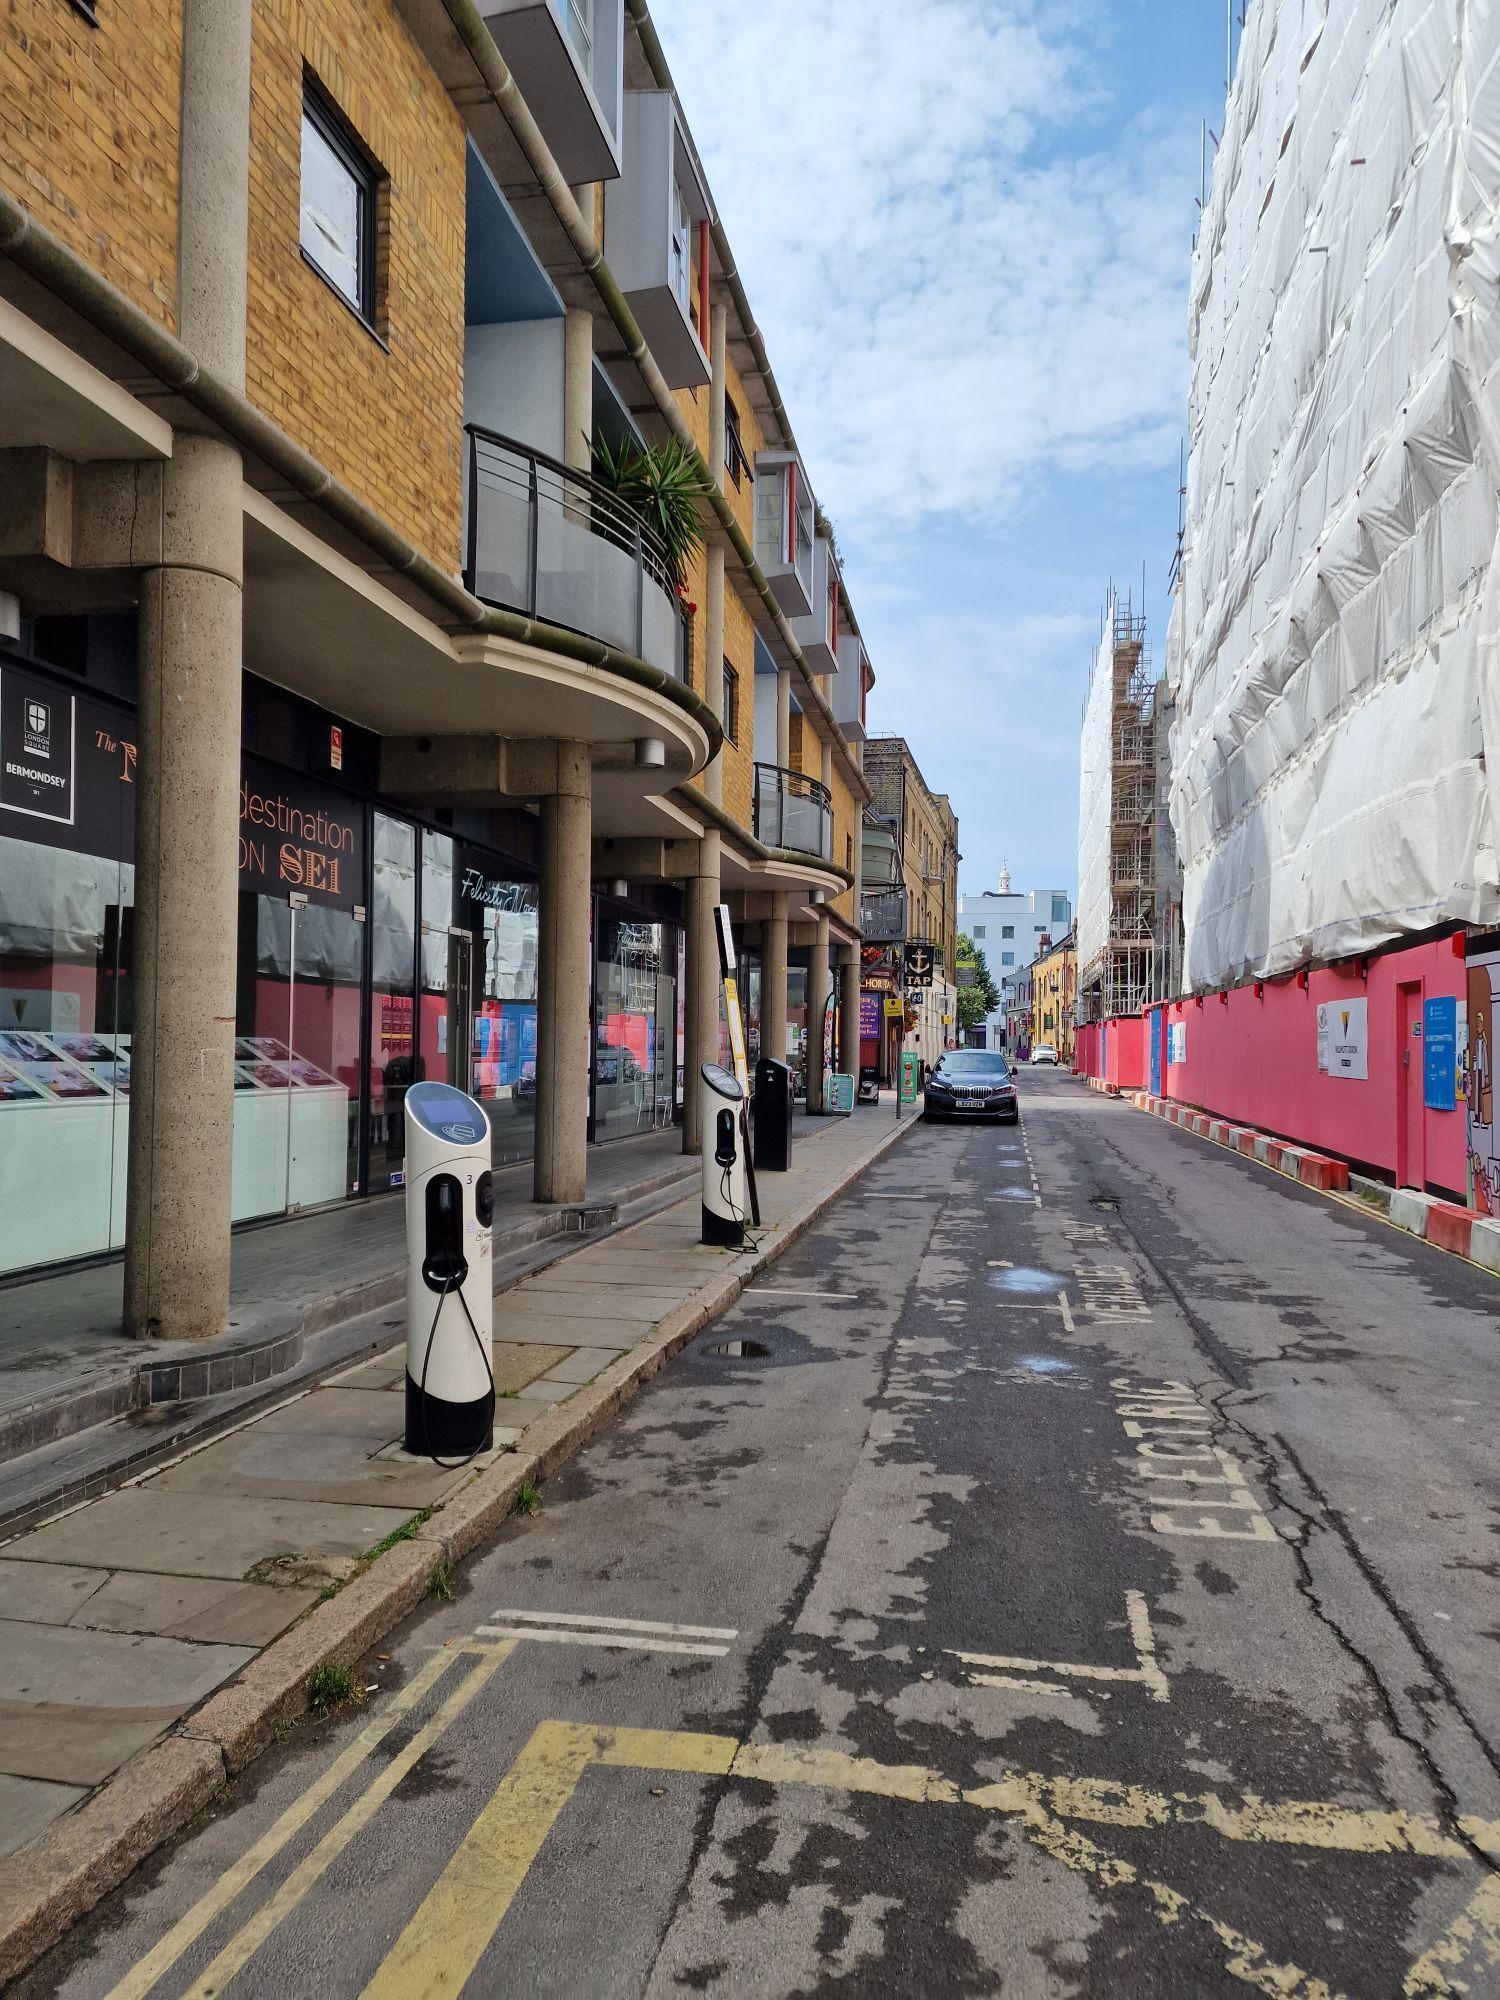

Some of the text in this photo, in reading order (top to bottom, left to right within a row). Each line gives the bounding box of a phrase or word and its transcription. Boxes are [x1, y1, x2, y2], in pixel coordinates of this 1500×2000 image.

[24, 733, 50, 746] LONDON
[24, 739, 50, 752] SQUARE
[95, 731, 117, 753] The
[6, 762, 66, 788] BERMONDSEY
[239, 780, 354, 854] destination
[279, 843, 341, 894] SE1
[461, 867, 508, 913] Felicity
[906, 976, 931, 986] TAP
[466, 1174, 473, 1185] 3
[1072, 1264, 1155, 1324] VEHICLES
[1109, 1377, 1280, 1542] ELECTRIC
